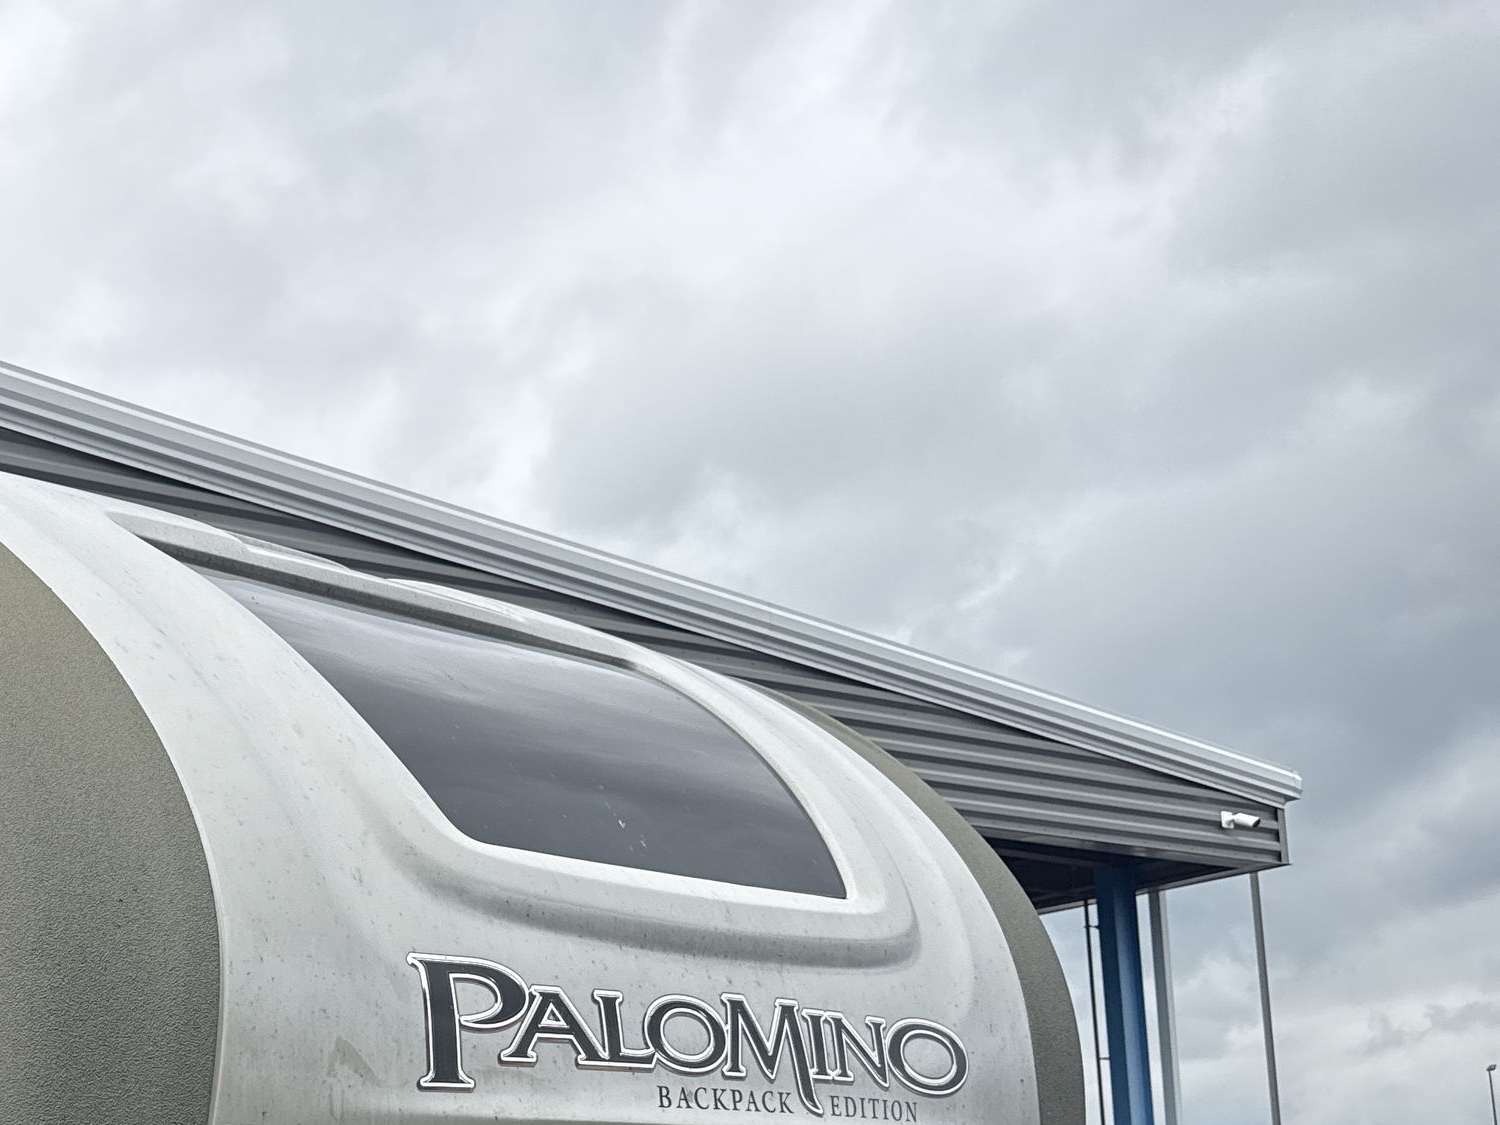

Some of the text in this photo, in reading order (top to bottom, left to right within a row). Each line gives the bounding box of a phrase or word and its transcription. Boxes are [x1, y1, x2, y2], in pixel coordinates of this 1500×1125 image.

[406, 952, 970, 1116] PALOMINO
[657, 1084, 920, 1123] BACKPACK EDITION
